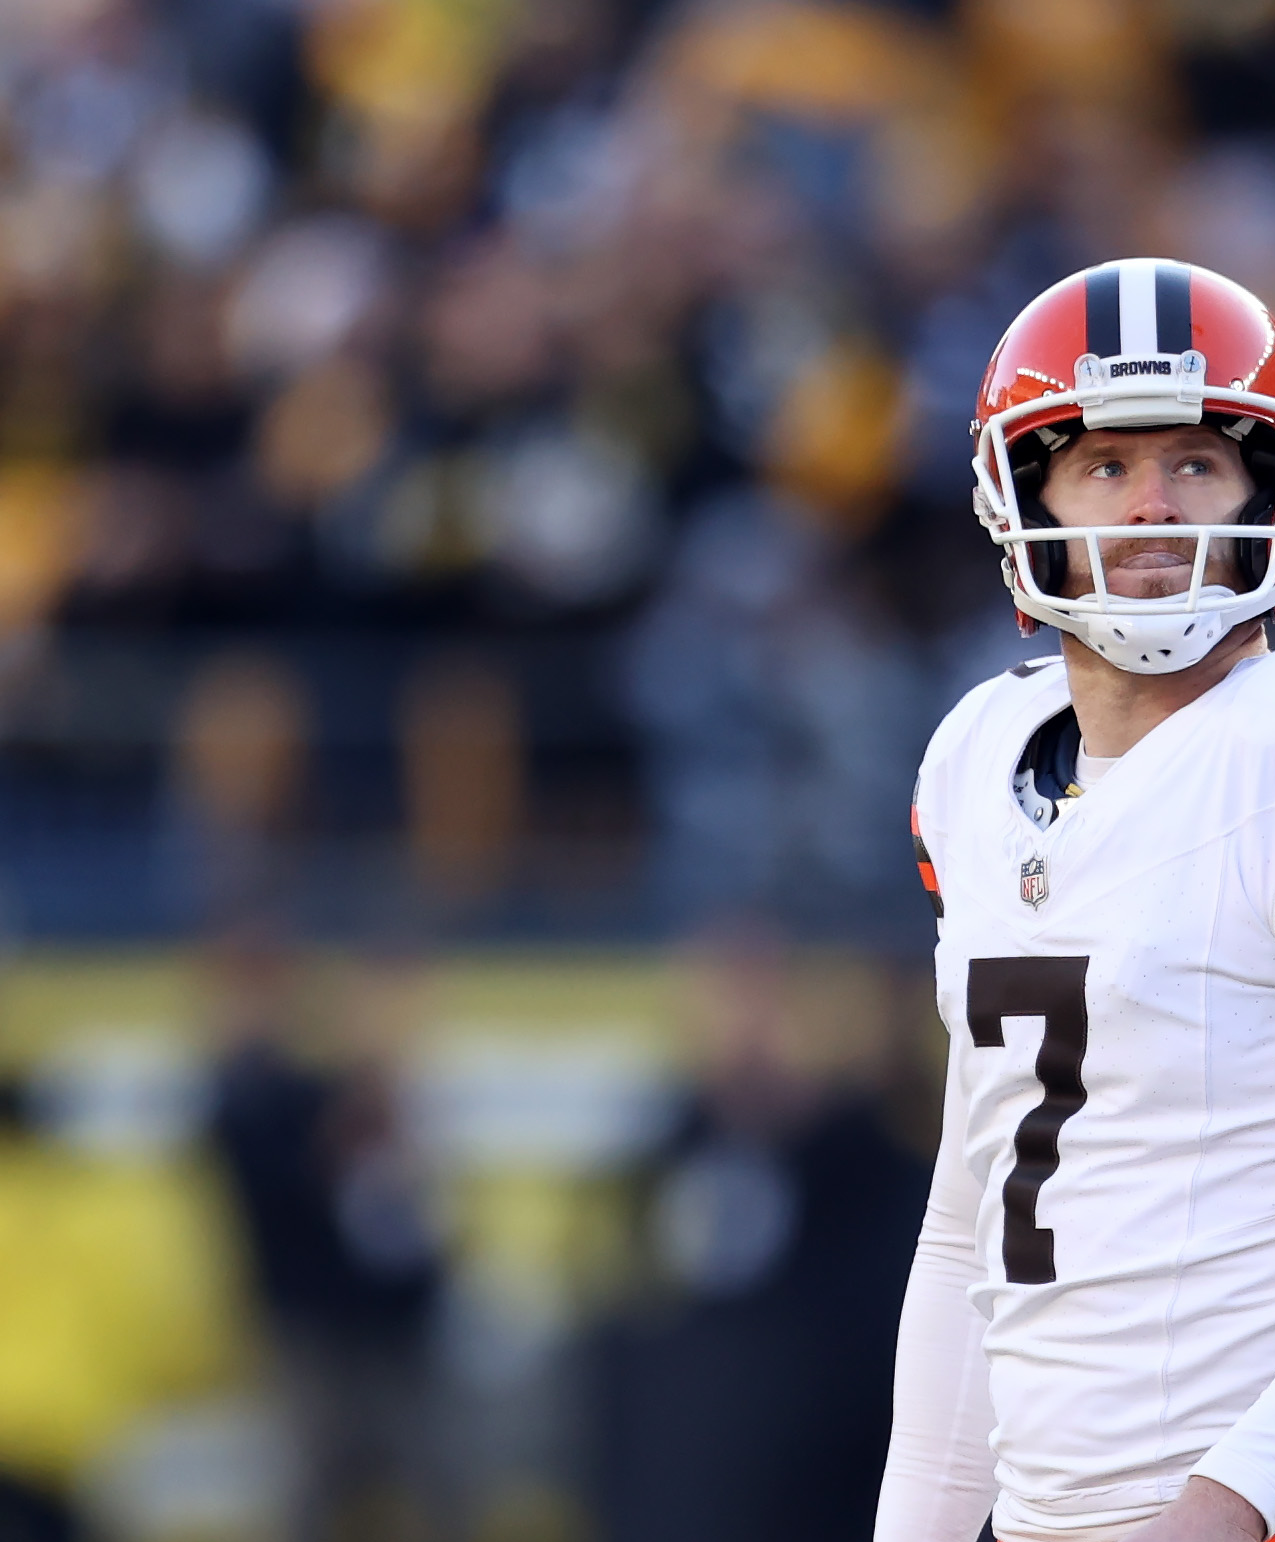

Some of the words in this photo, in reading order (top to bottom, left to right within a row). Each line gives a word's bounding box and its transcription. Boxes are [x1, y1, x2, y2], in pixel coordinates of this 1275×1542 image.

[1110, 360, 1172, 378] BROWNS
[1022, 875, 1044, 900] NFL
[966, 955, 1090, 1284] 7
